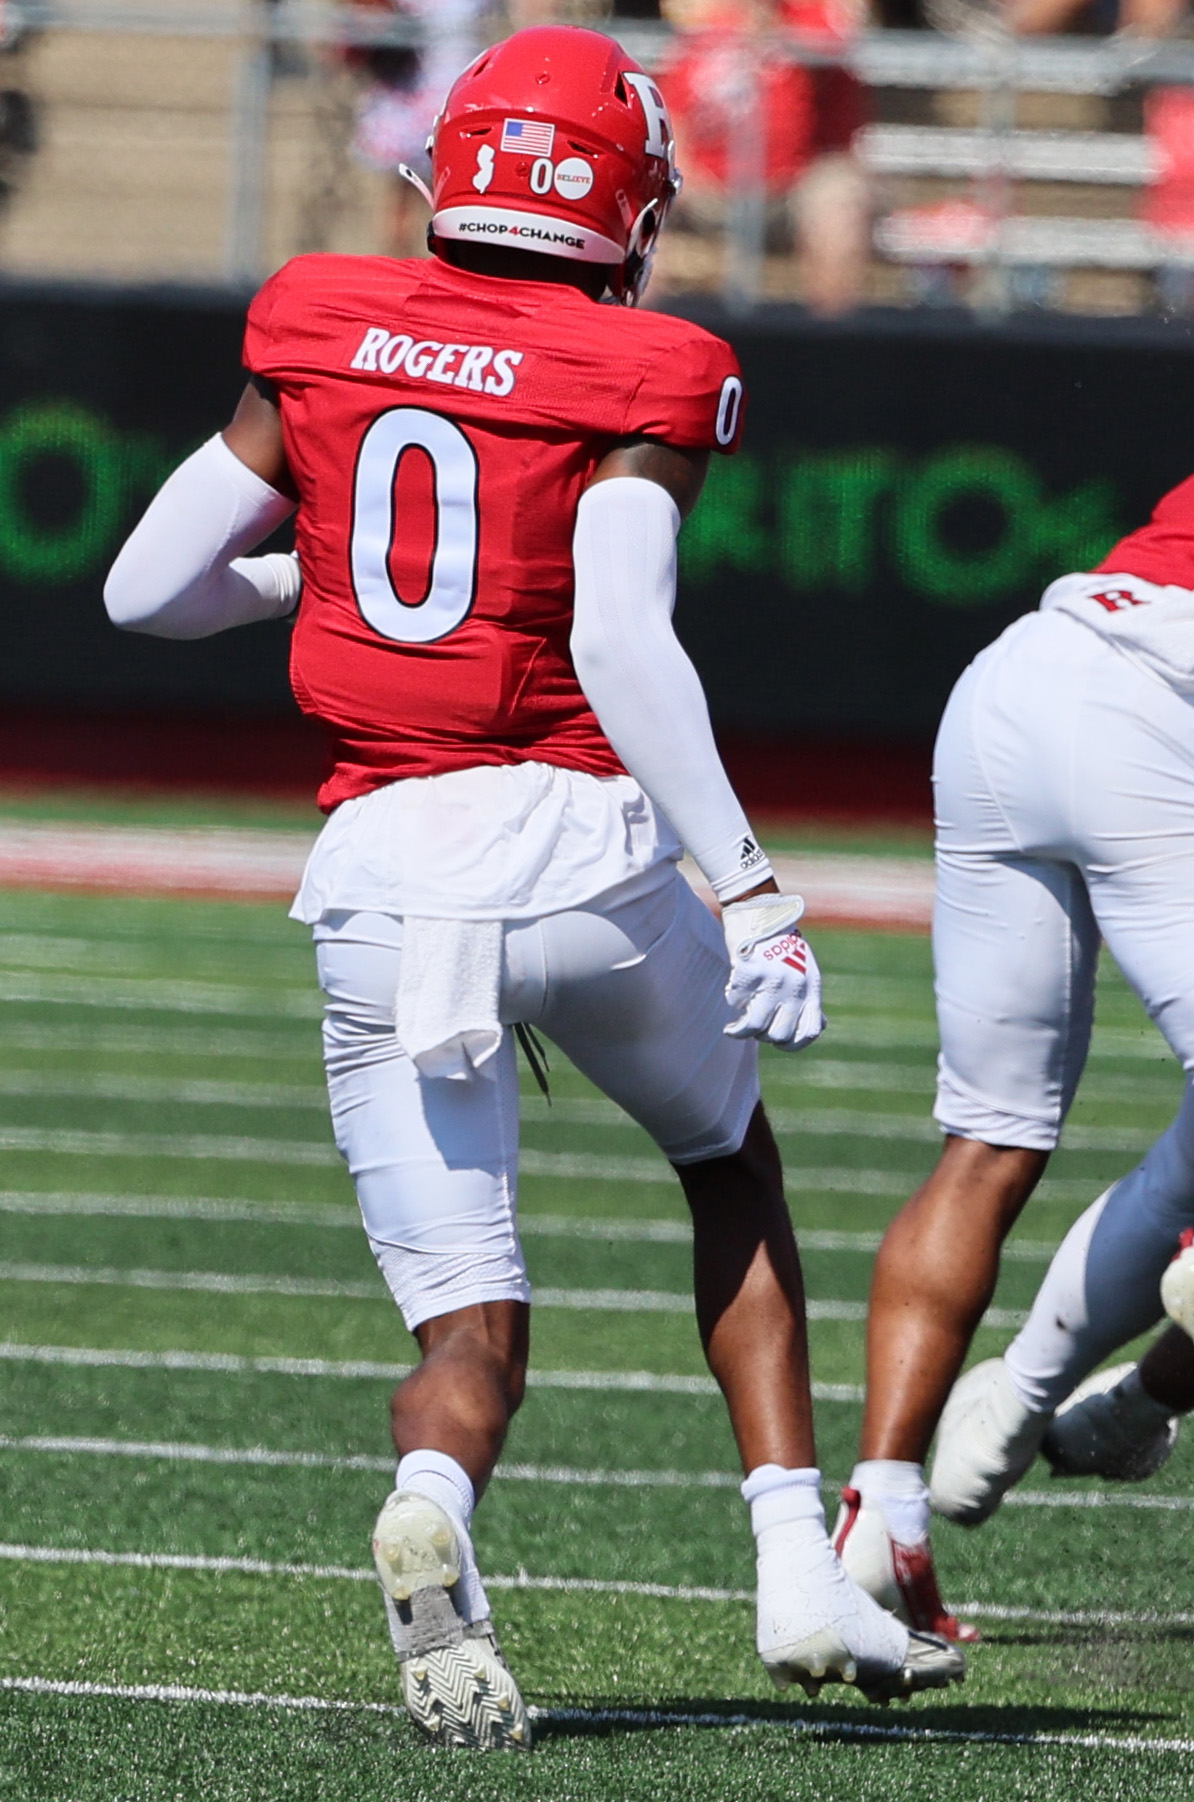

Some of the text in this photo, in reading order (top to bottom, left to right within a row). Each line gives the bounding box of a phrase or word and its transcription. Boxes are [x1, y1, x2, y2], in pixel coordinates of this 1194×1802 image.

[530, 158, 555, 195] 0
[557, 173, 591, 184] BELIEVE
[458, 222, 586, 250] #CHOP4CHANGE
[350, 327, 524, 397] ROGERS
[715, 375, 743, 446] 0
[351, 404, 480, 644] 0
[1087, 590, 1150, 613] R
